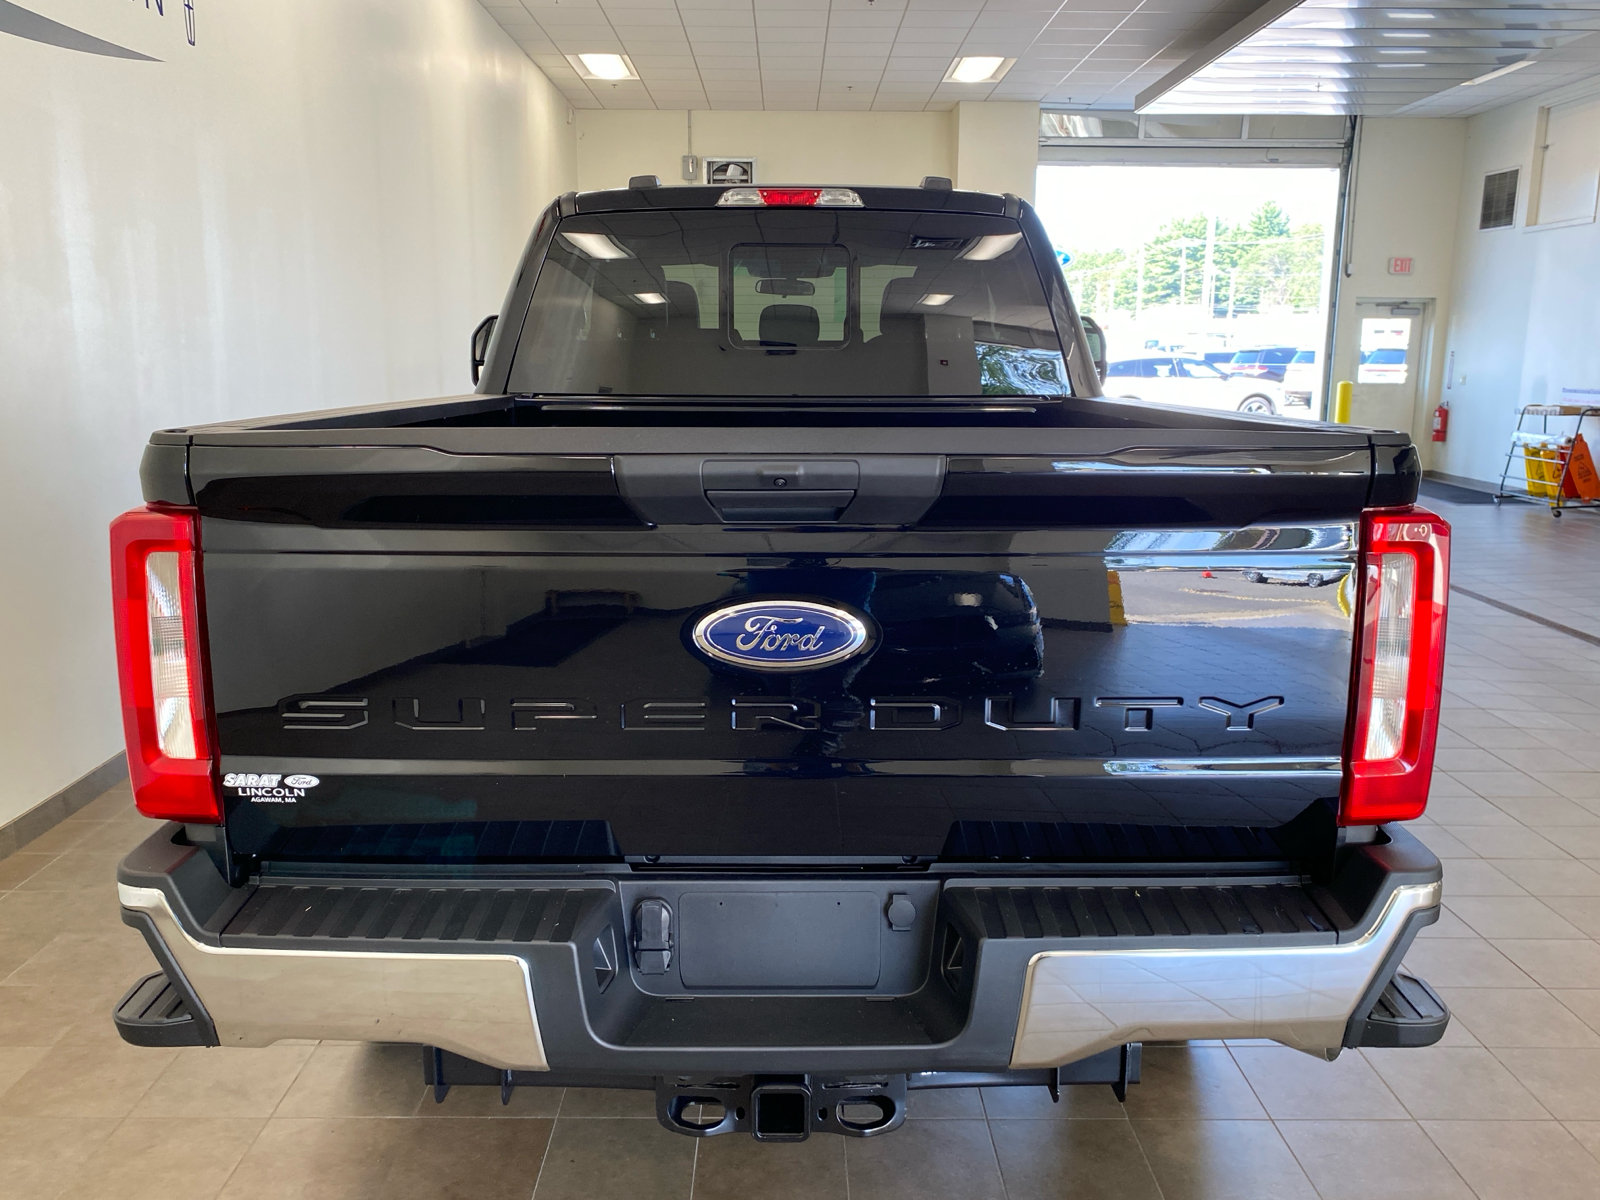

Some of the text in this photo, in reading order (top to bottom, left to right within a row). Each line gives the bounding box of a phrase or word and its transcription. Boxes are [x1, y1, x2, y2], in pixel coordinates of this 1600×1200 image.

[1393, 257, 1412, 273] EXIT
[735, 615, 826, 652] Ford
[281, 695, 1285, 731] SUPER DUTY
[223, 773, 281, 788] SARAT
[238, 787, 305, 797] LINCOLN
